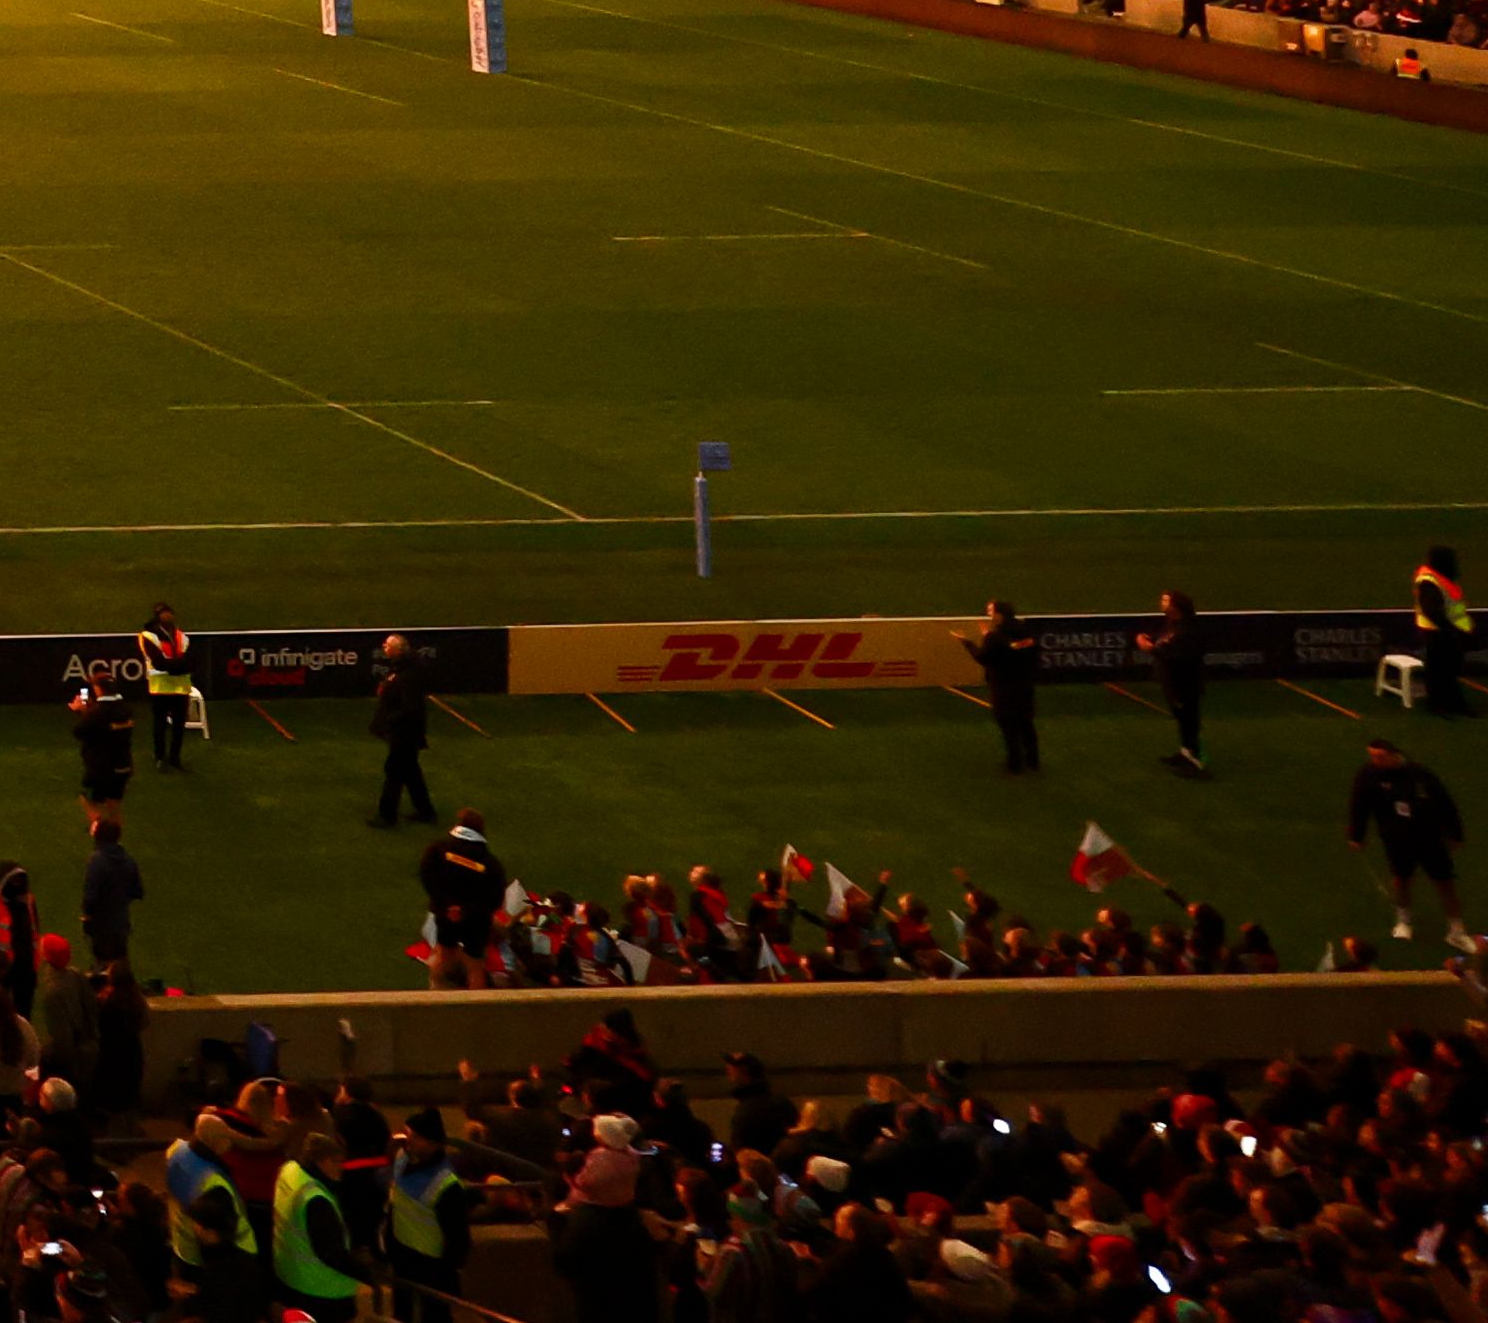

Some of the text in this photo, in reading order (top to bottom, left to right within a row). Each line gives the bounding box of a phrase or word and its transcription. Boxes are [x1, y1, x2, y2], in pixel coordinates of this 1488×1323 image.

[1040, 631, 1126, 649] CHARLES
[63, 654, 143, 682] Acro
[660, 633, 876, 681] DHL
[1040, 651, 1125, 669] STANLEY
